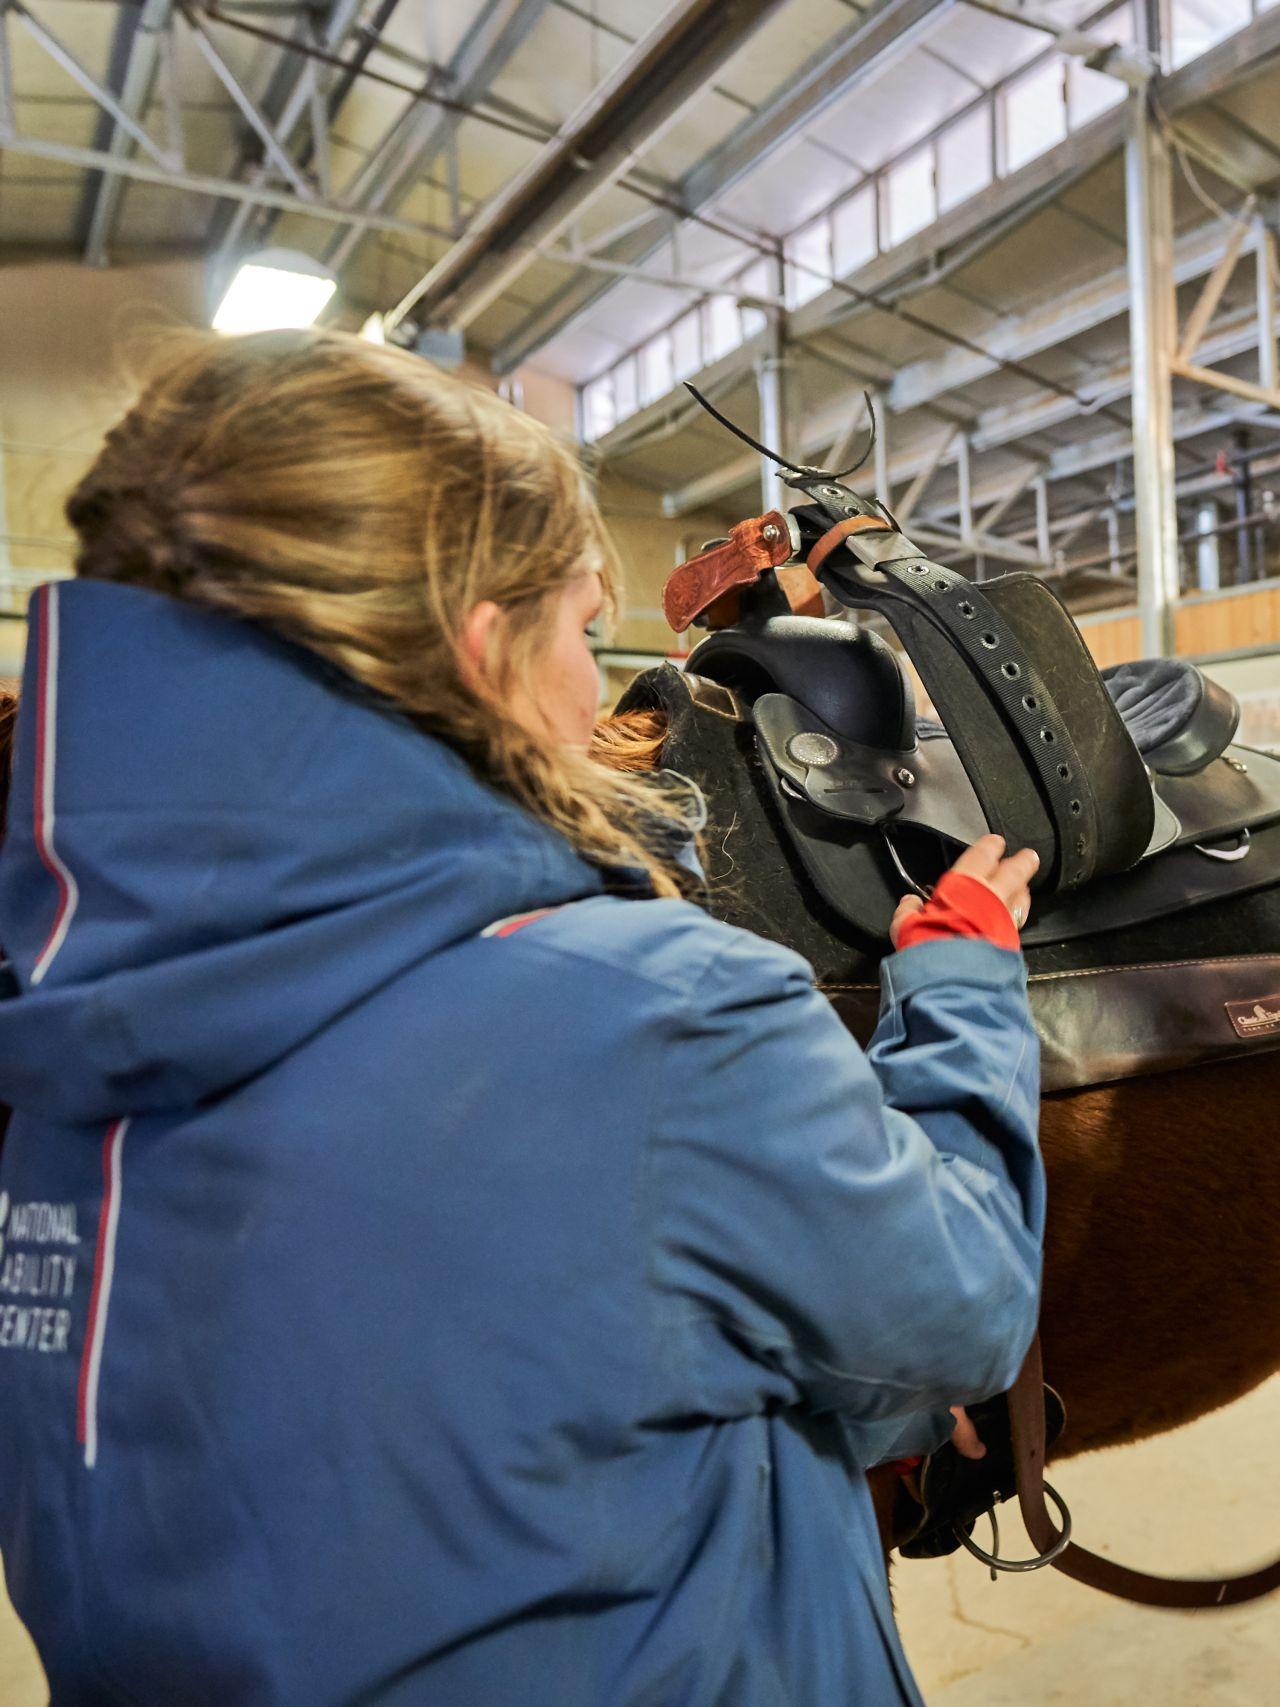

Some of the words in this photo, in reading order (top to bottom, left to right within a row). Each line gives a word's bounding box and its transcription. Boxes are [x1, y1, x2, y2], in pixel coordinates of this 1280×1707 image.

[7, 1202, 81, 1244] NATIONAL
[1, 1253, 77, 1297] ABILITY
[0, 1305, 71, 1351] ENTER
